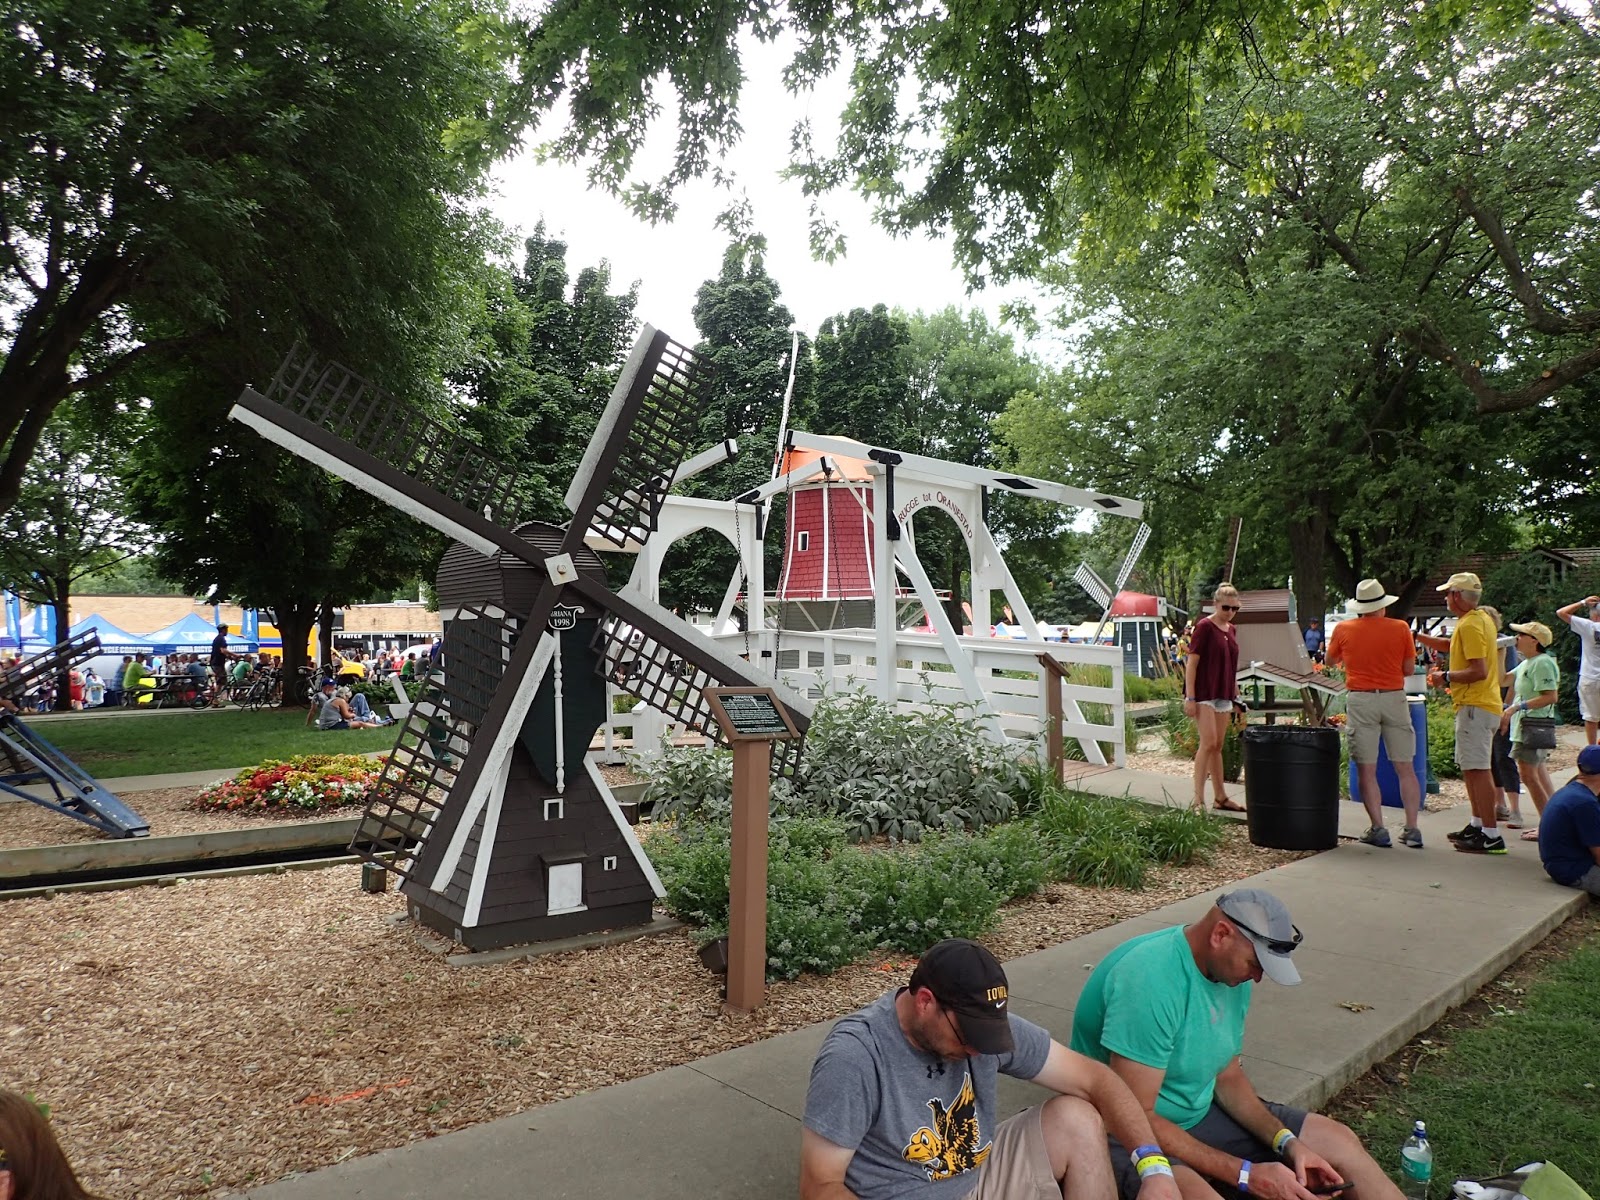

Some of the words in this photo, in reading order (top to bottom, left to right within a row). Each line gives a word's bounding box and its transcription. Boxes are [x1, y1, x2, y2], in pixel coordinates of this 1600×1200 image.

[898, 497, 919, 523] RUGGE
[554, 618, 571, 627] 1998
[194, 645, 212, 653] BICYC
